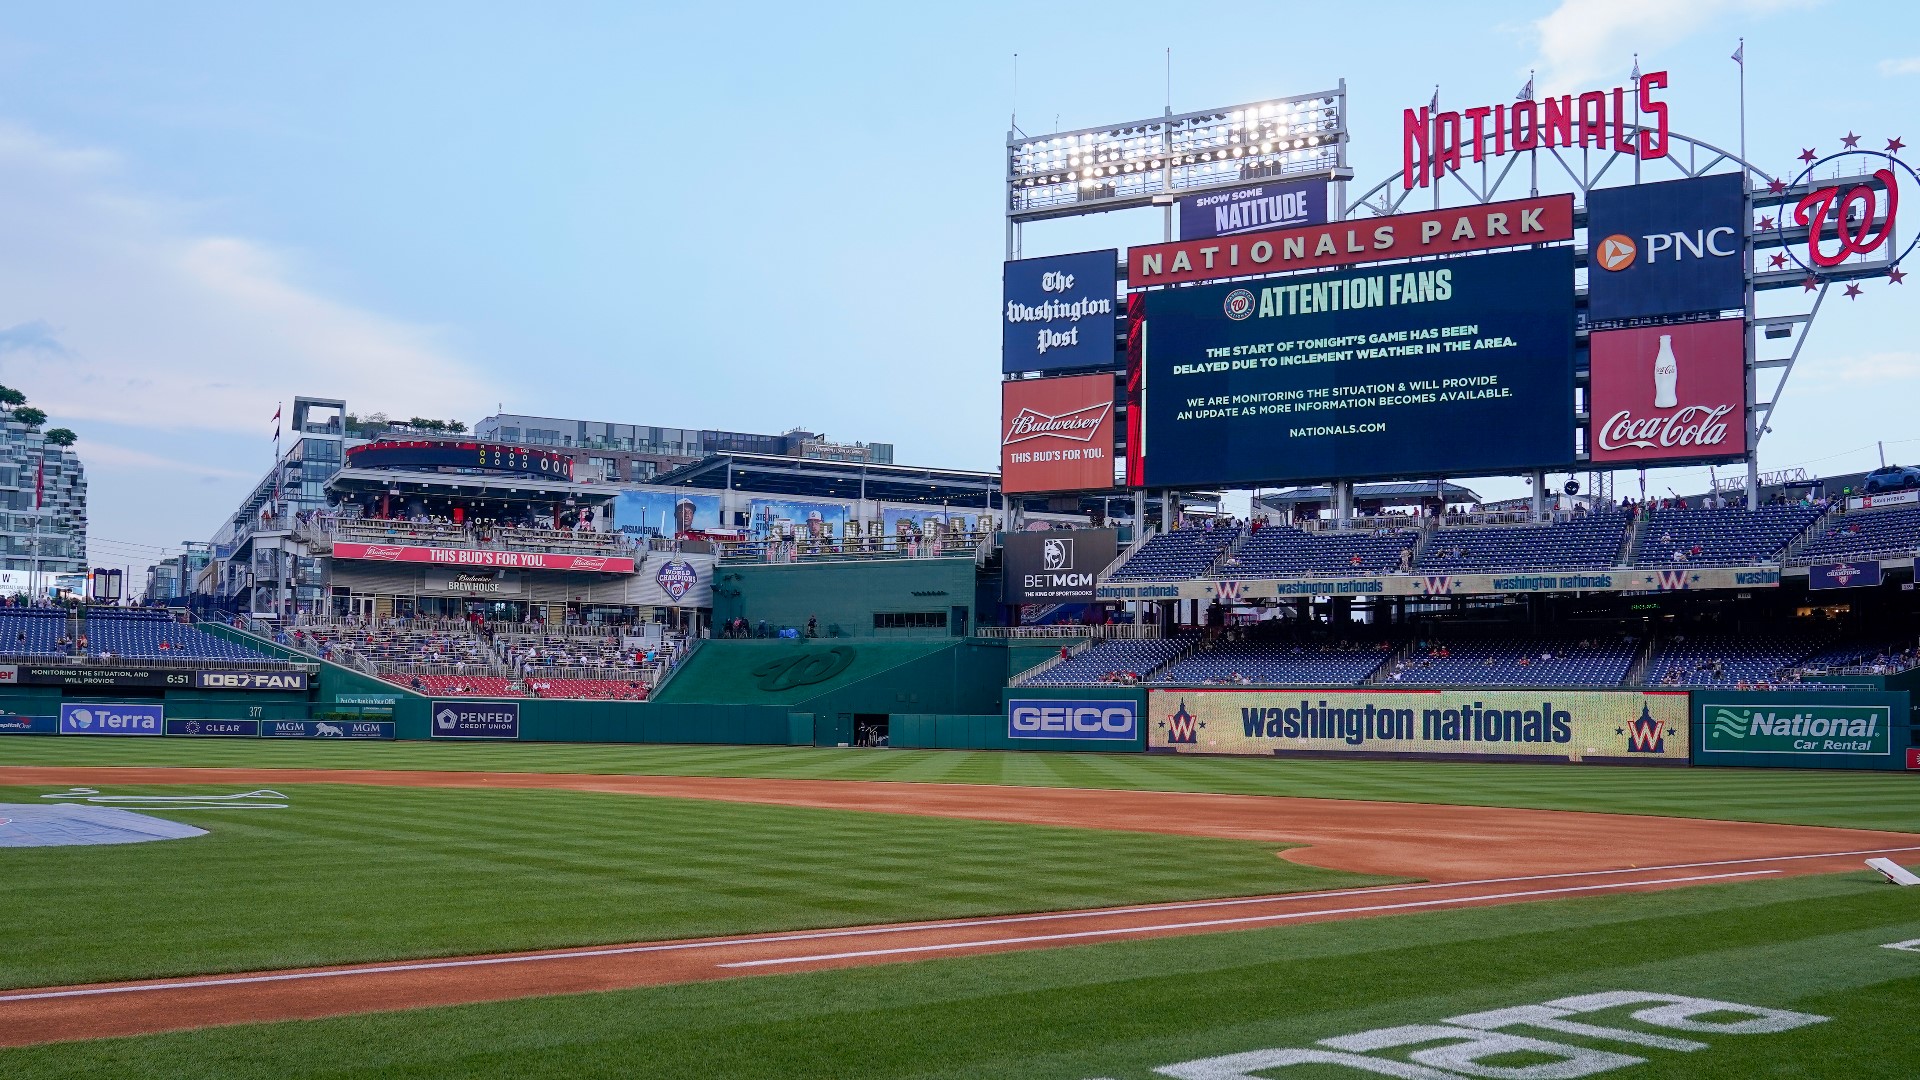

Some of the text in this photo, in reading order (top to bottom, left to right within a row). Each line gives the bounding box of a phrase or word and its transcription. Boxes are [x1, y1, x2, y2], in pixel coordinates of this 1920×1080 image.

[1404, 71, 1668, 190] NATIONALS
[1197, 188, 1263, 207] SHOW SOME
[1215, 190, 1308, 232] NATITUDE
[1794, 168, 1899, 267] W
[1142, 208, 1546, 276] NATIONALS PARK
[1643, 226, 1736, 264] PNC
[1042, 270, 1075, 294] The
[1258, 268, 1452, 318] ATTENTION FANS
[1007, 296, 1112, 323] Washington
[1037, 326, 1079, 354] Post
[1206, 325, 1478, 358] THE START OF TONIGHT'S GAME HAS BEEN
[1173, 337, 1517, 375] DELAYED DUE TO INCLEMENT WEATHER IN THE AREA.
[1187, 375, 1498, 408] WE ARE MONITORING THE SITUATION & WILL PROVIDE
[1176, 388, 1513, 420] AN UPDATE AS MORE INFORMATION BECOMES AVAILABLE.
[1011, 415, 1101, 435] Budweiser
[1290, 423, 1386, 437] NATIONALS.COM
[1598, 403, 1736, 450] Coca-Cola
[1011, 448, 1105, 463] THIS BUD'S FOR YOU.
[643, 526, 660, 535] GRAY
[366, 548, 400, 558] Budweiser
[430, 549, 546, 567] THIS BUD'S FOR YOU.
[574, 558, 604, 569] Budweiser
[456, 573, 492, 582] Budweiser
[659, 575, 696, 583] CHAMPIONS
[1024, 573, 1093, 588] BETMGM
[1493, 574, 1612, 591] washington nationals
[448, 582, 499, 592] BREW HOUSE
[1137, 584, 1179, 598] nationals
[1277, 579, 1383, 595] washington nationals
[94, 670, 133, 678] SITUATION,
[167, 675, 189, 684] 6:51
[255, 675, 300, 688] FAN
[95, 711, 155, 728] Terra
[249, 706, 262, 718] 377
[460, 712, 512, 723] PENFED
[1013, 707, 1132, 732] GEICO
[206, 724, 240, 732] CLEAR
[276, 722, 304, 731] MGM
[352, 724, 380, 732] MGM
[1241, 701, 1571, 745] washington nationals
[1750, 712, 1878, 737] National
[1793, 740, 1871, 751] Car Rental
